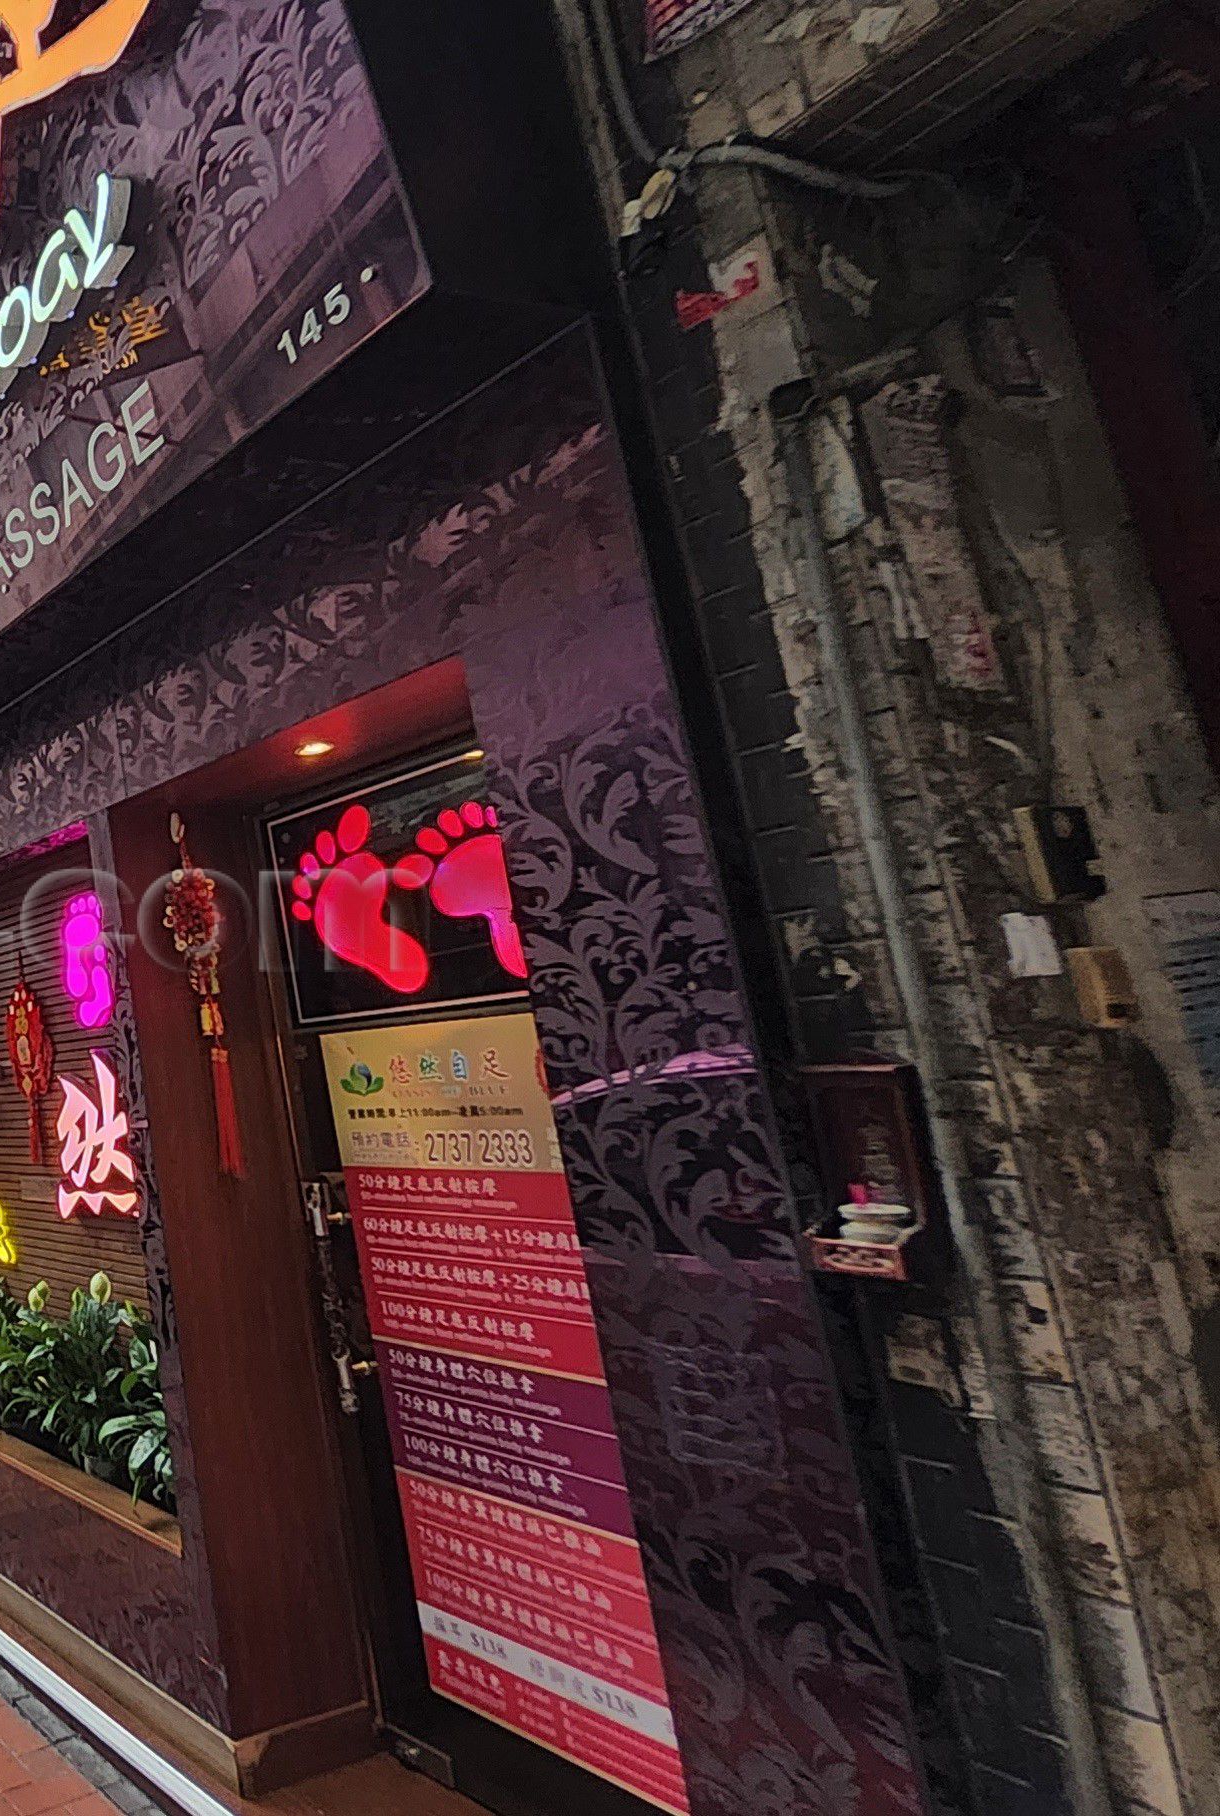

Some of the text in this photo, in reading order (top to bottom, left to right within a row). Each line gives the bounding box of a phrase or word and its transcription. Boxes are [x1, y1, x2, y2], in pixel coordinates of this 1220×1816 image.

[276, 282, 351, 365] 145
[424, 1131, 472, 1163] 2737
[479, 1131, 534, 1164] 2333
